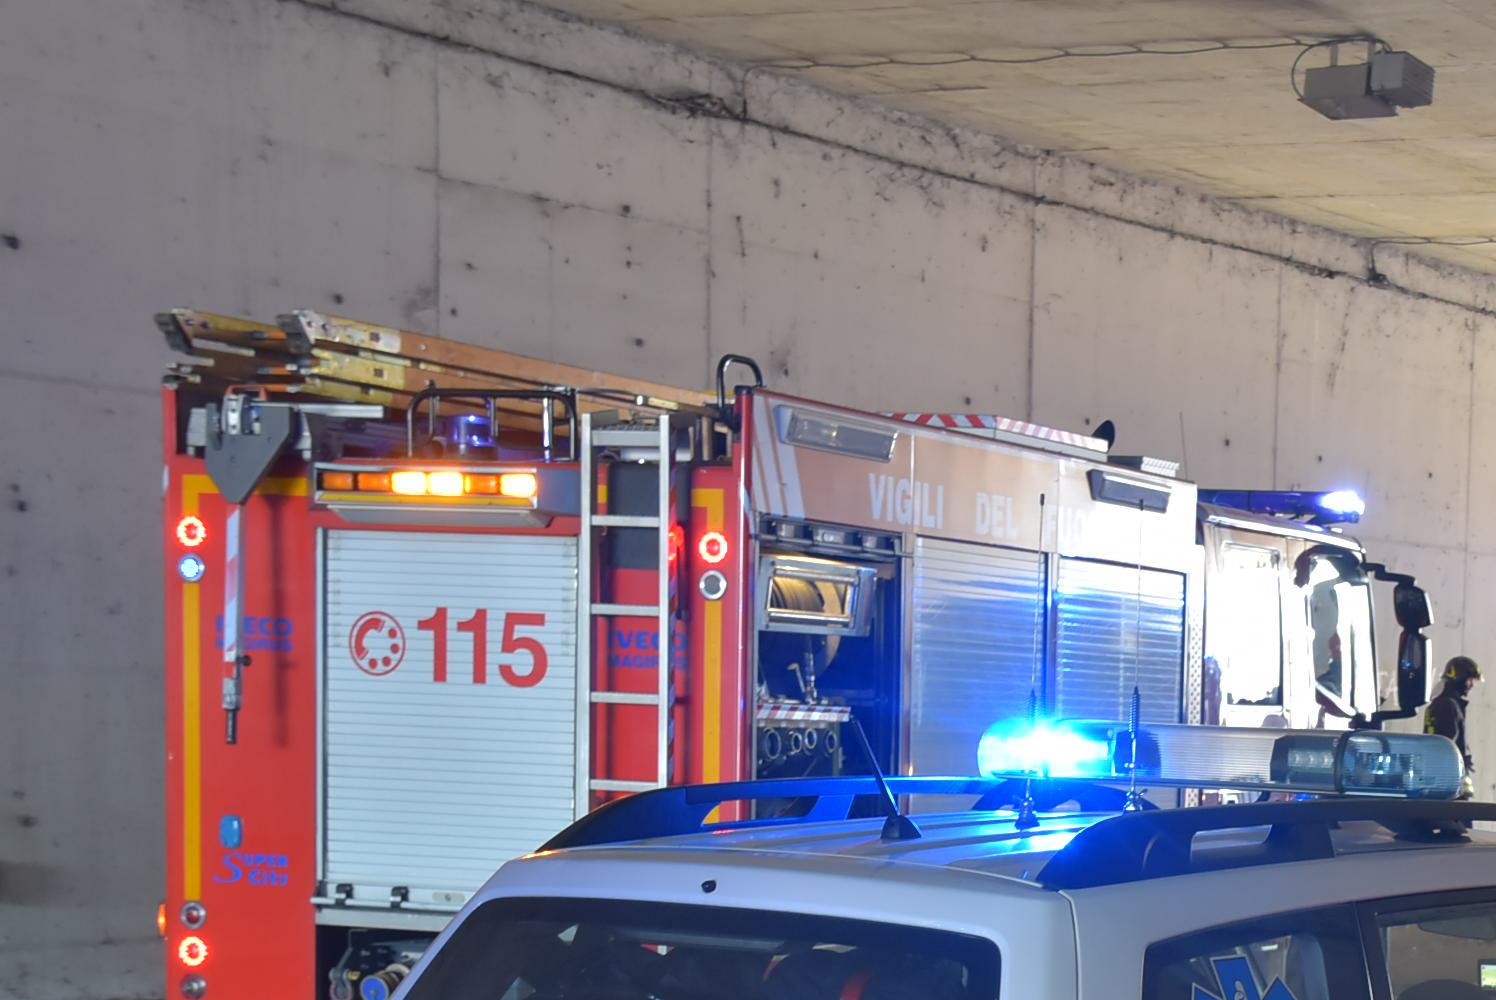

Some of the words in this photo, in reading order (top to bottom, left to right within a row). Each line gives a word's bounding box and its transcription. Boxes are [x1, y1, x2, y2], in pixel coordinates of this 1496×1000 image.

[868, 473, 944, 530] VIGILI
[975, 491, 1018, 539] DEL
[417, 606, 549, 688] 115
